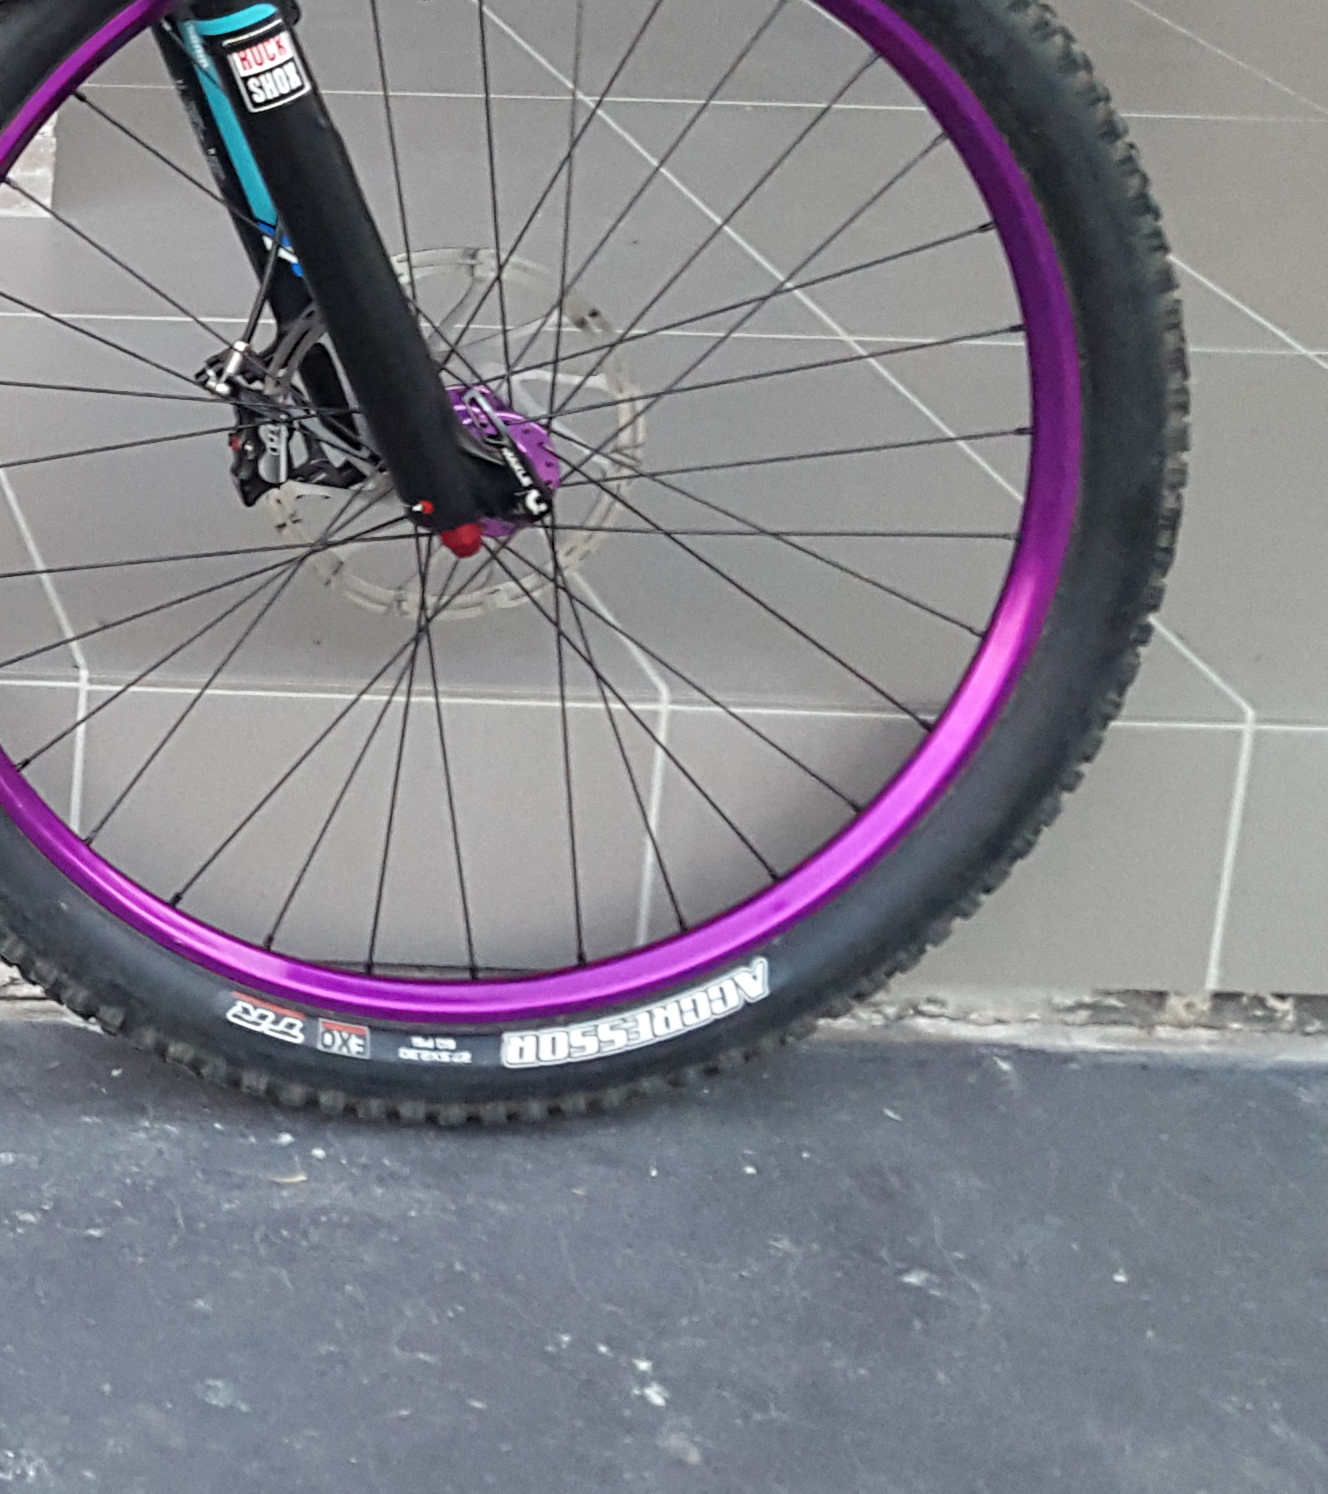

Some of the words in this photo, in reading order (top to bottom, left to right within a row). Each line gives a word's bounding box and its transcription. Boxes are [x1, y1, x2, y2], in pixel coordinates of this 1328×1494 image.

[237, 36, 288, 71] ROCK
[247, 61, 303, 103] SHOX
[225, 1000, 306, 1044] TR
[500, 956, 771, 1068] AGGRESSOR
[319, 1024, 368, 1058] EXO
